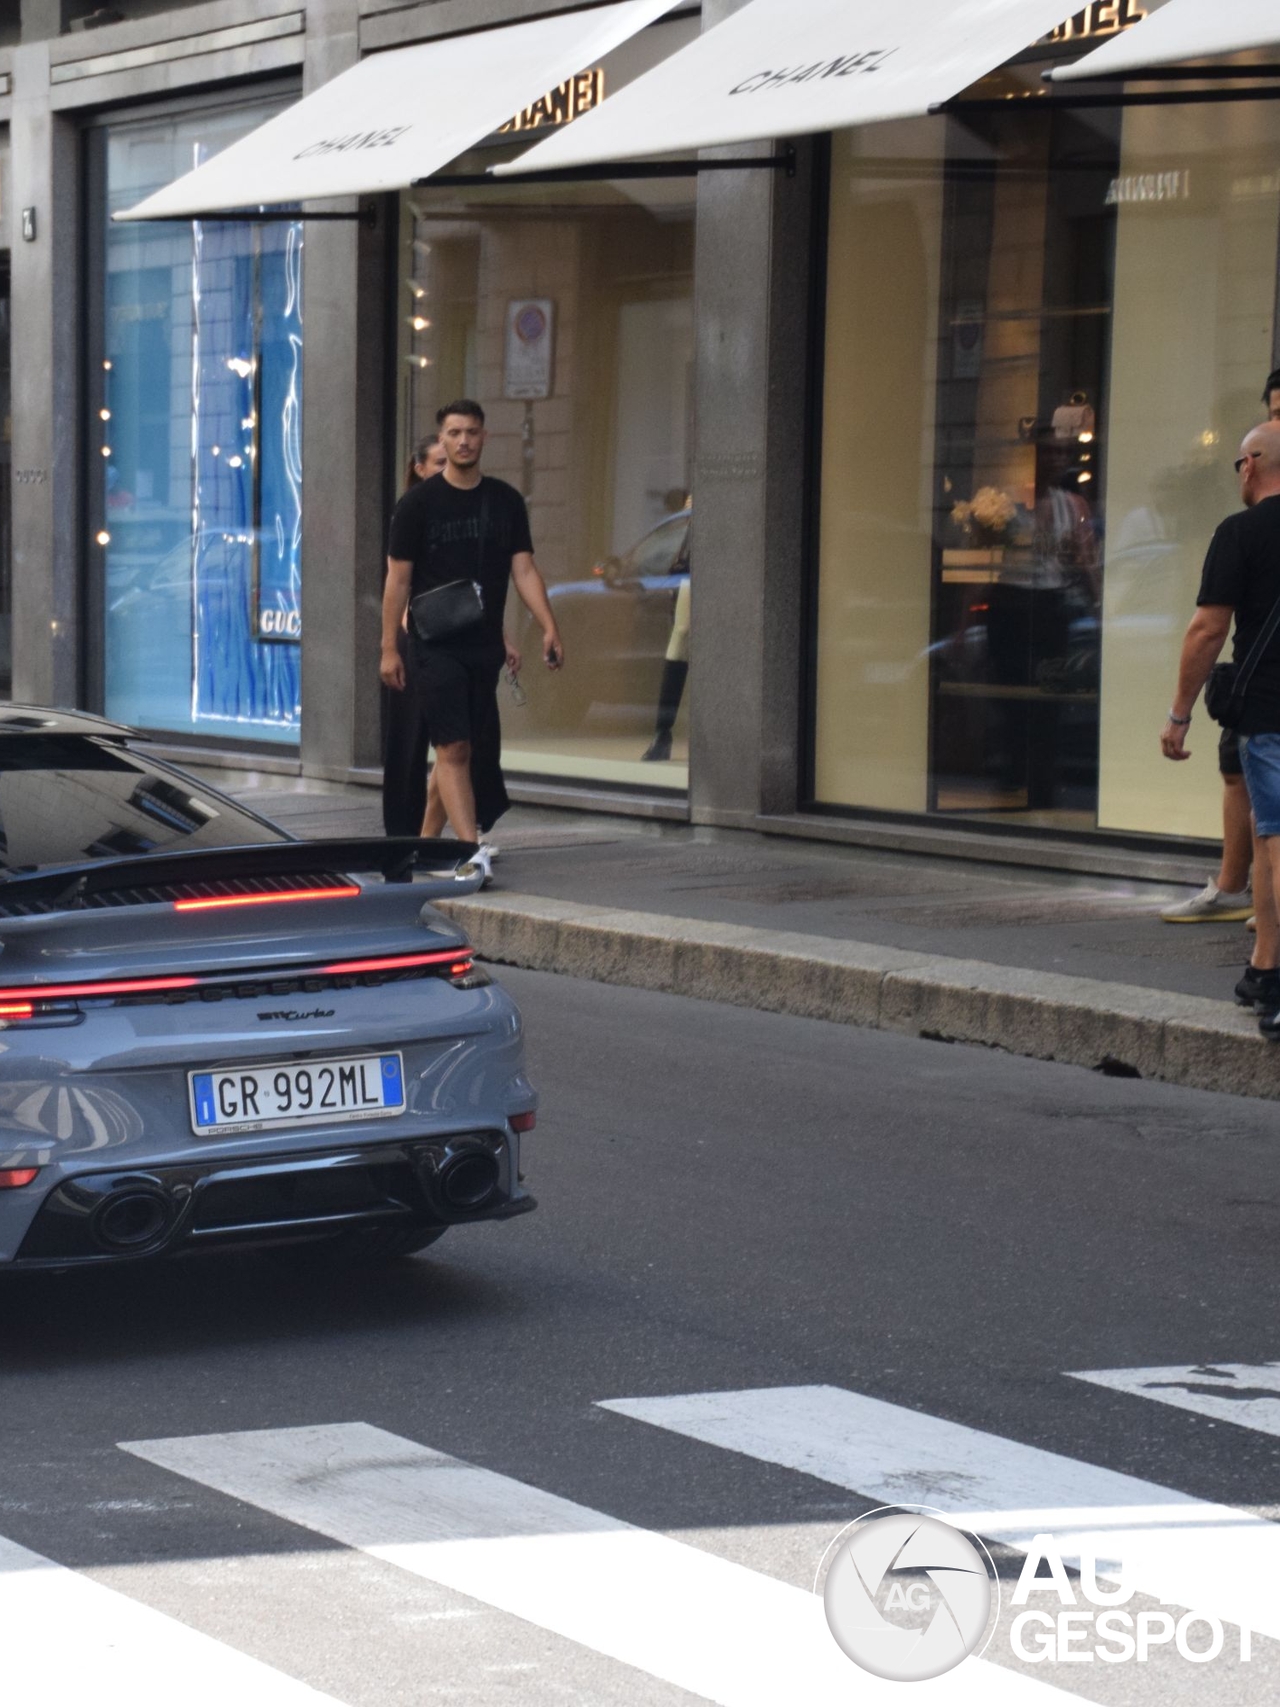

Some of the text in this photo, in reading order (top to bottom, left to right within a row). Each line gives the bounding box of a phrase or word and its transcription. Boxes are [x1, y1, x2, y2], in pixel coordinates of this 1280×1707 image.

[728, 47, 900, 95] CHANEL
[293, 124, 412, 160] CHANEL
[218, 1064, 379, 1118] GR 992ML
[208, 1123, 263, 1134] PORSCHE
